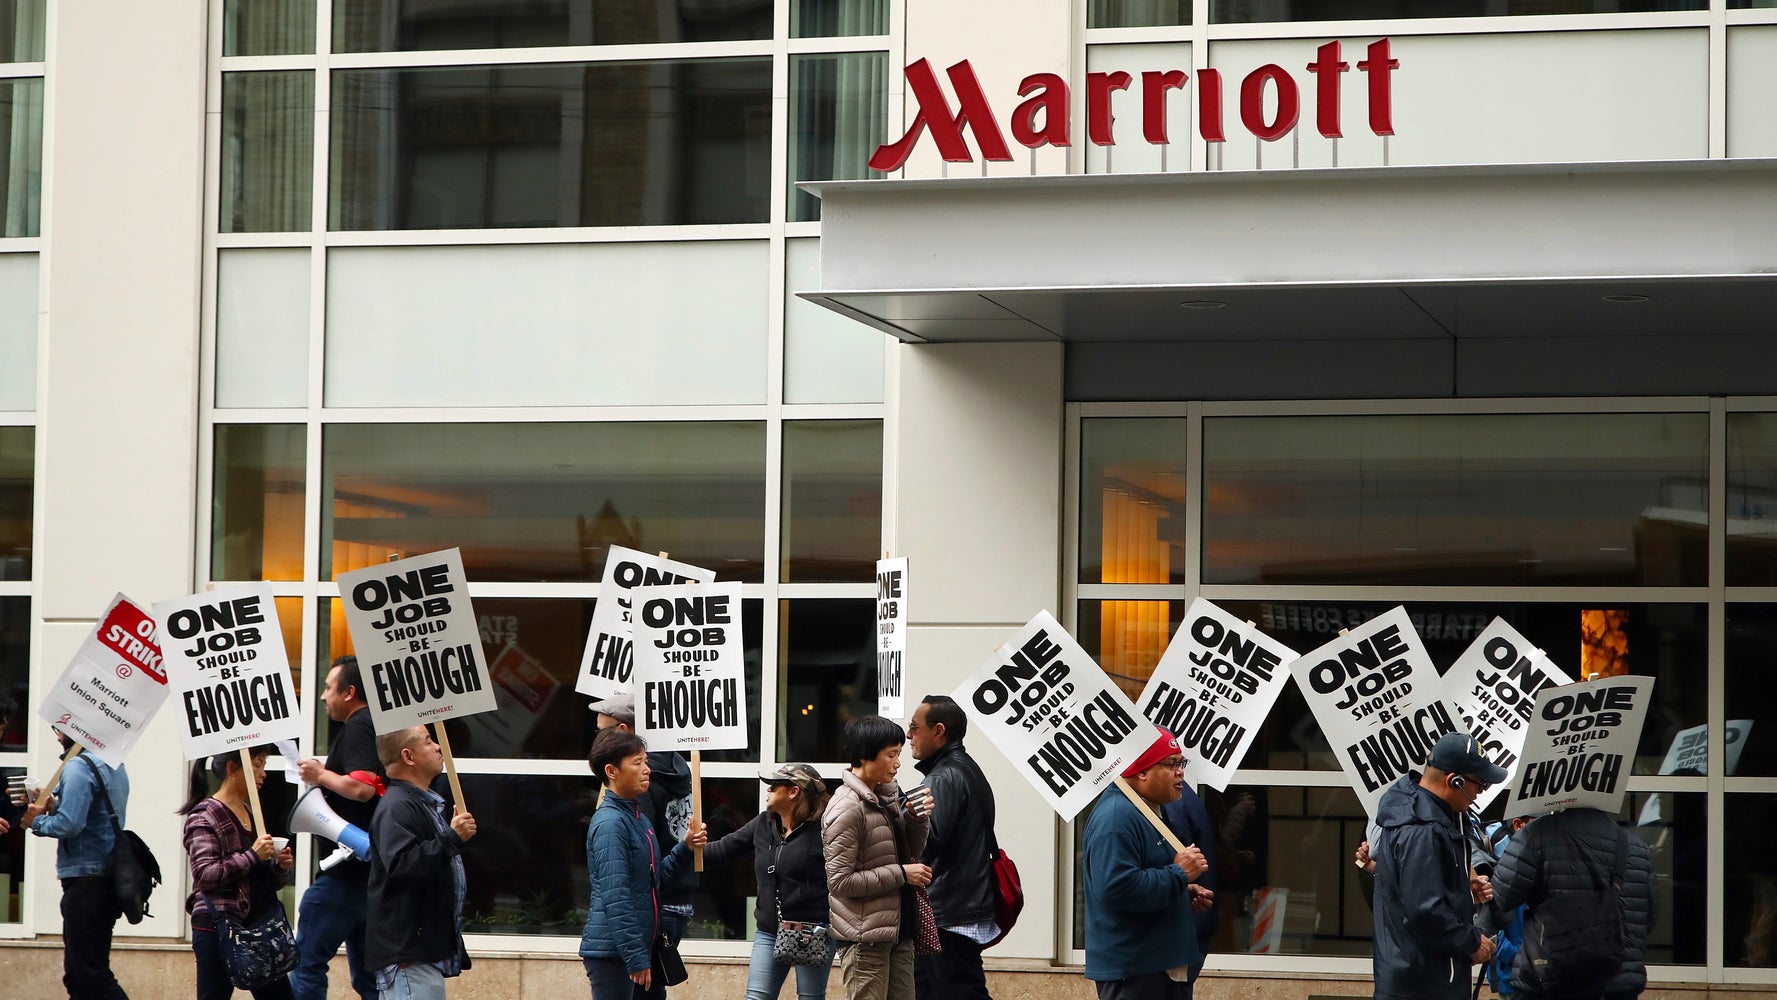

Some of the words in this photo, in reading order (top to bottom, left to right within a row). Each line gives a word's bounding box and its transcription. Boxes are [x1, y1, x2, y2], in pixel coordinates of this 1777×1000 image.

[867, 37, 1400, 173] Marriott
[352, 564, 454, 611] ONE
[613, 561, 700, 589] ON
[167, 595, 265, 639] ONE
[371, 597, 452, 630] JOB
[642, 595, 731, 628] ONE
[878, 601, 898, 621] JOB
[184, 627, 262, 657] JOB
[384, 619, 447, 643] SHOULD
[409, 637, 430, 653] BE
[653, 627, 726, 648] JOB
[1191, 616, 1282, 683] ONE
[105, 624, 166, 678] STRIKE
[198, 649, 257, 671] SHOULD
[589, 632, 634, 684] ENO
[663, 649, 719, 663] SHOULD
[1309, 624, 1410, 694] ONE
[221, 666, 240, 680] BE
[371, 643, 482, 712] ENOUGH
[683, 665, 701, 677] BE
[972, 628, 1063, 715] ONE
[1188, 651, 1260, 695] JOB
[1188, 667, 1243, 704] SHOULD
[1335, 658, 1413, 710] JOB
[70, 682, 97, 706] Union
[98, 702, 131, 729] Square
[91, 677, 129, 708] Marriott
[182, 672, 289, 738] ENOUGH
[645, 678, 738, 730] ENOUGH
[1005, 660, 1071, 725] JOB
[1022, 682, 1075, 732] SHOULD
[1199, 689, 1220, 707] BE
[1351, 682, 1413, 721] SHOULD
[1471, 685, 1522, 731] SHOULD
[1541, 686, 1638, 721] ONE
[1049, 706, 1070, 729] BE
[1143, 681, 1246, 769] ENOUGH
[1379, 705, 1401, 724] BE
[1478, 709, 1497, 729] BE
[1546, 712, 1622, 736] JOB
[1027, 689, 1138, 798] ENOUGH
[1346, 700, 1458, 793] ENOUGH
[1551, 730, 1610, 748] SHOULD
[1567, 743, 1586, 756] BE
[1517, 752, 1624, 801] ENOUGH
